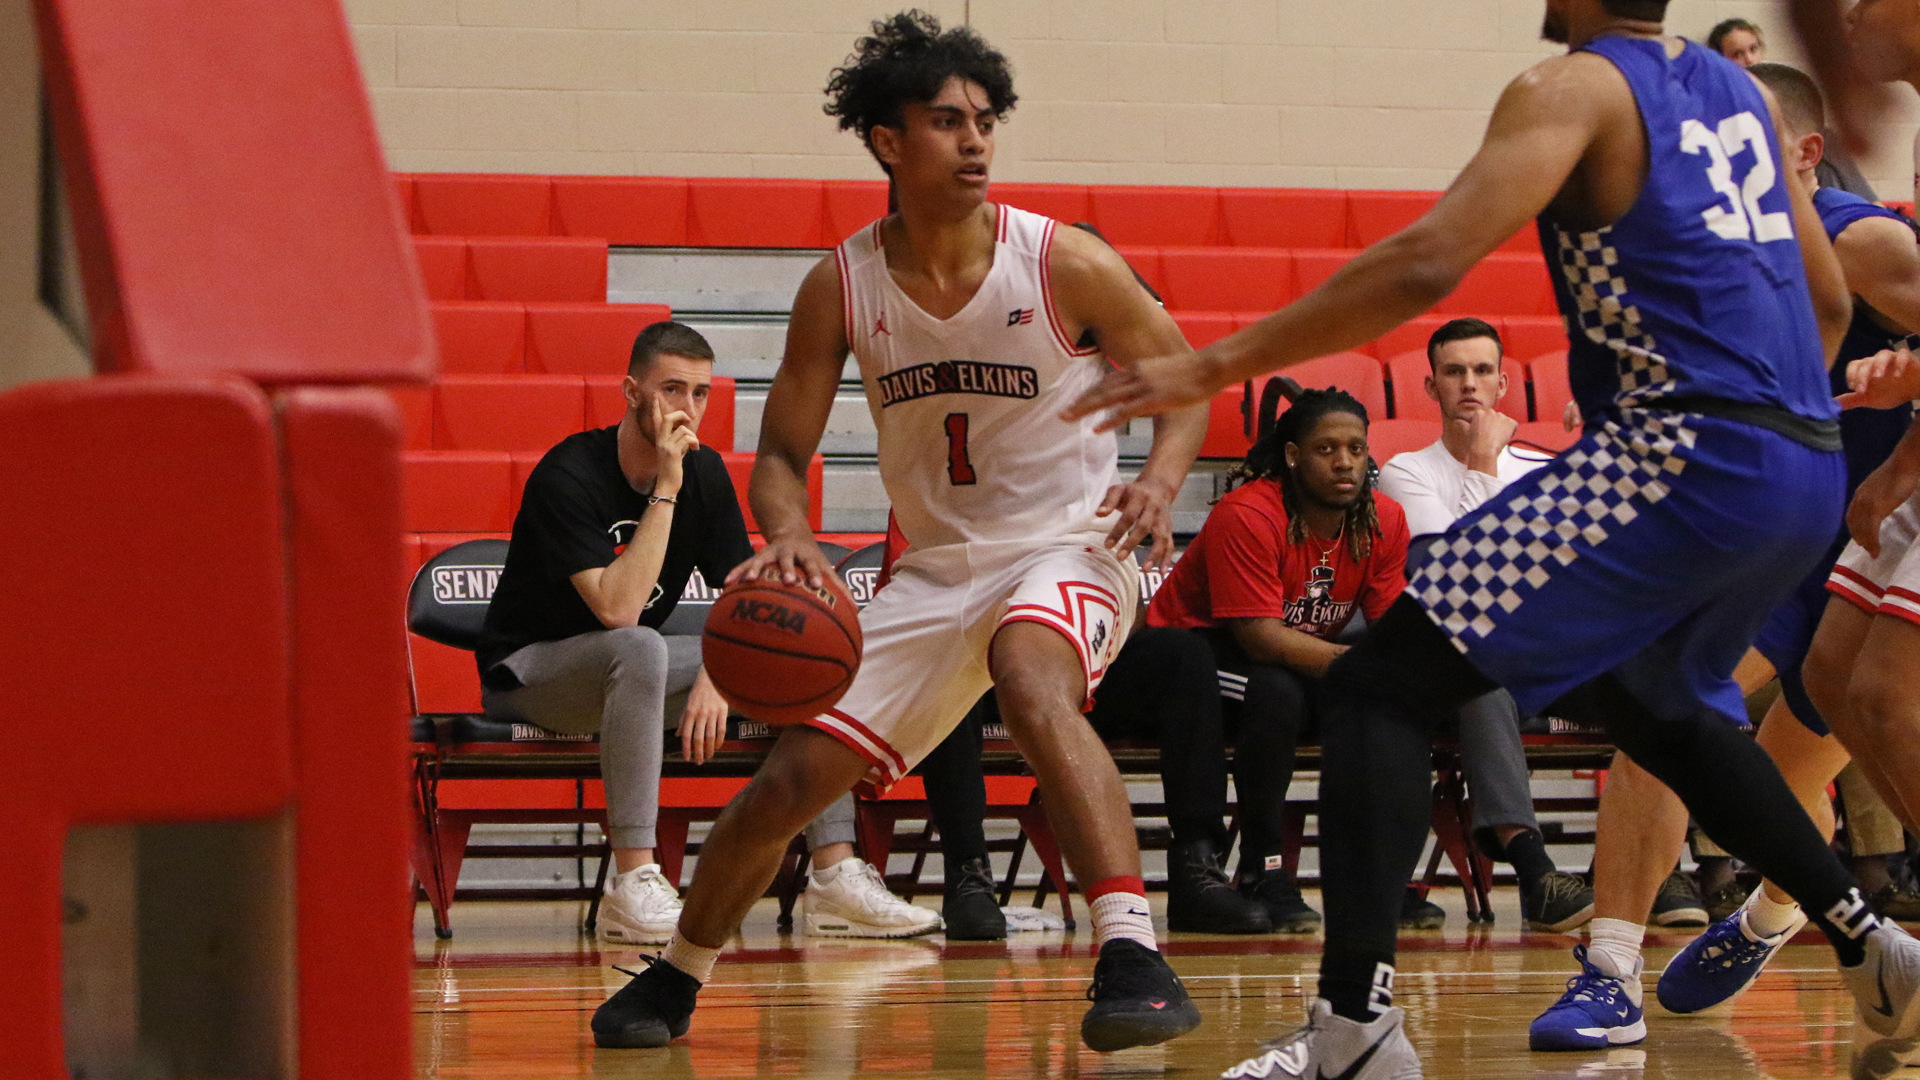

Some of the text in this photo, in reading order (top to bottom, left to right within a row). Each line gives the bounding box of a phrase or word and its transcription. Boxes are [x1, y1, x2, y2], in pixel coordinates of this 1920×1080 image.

[1680, 111, 1794, 243] 32
[881, 363, 1036, 404] DAVIS & ELKINS
[944, 413, 976, 486] 1
[437, 569, 503, 599] SENA
[730, 599, 807, 635] NCAA
[1283, 603, 1305, 624] VIS
[514, 725, 545, 739] DAVIS
[741, 722, 769, 737] DAVIS
[982, 724, 1010, 738] ELKIN
